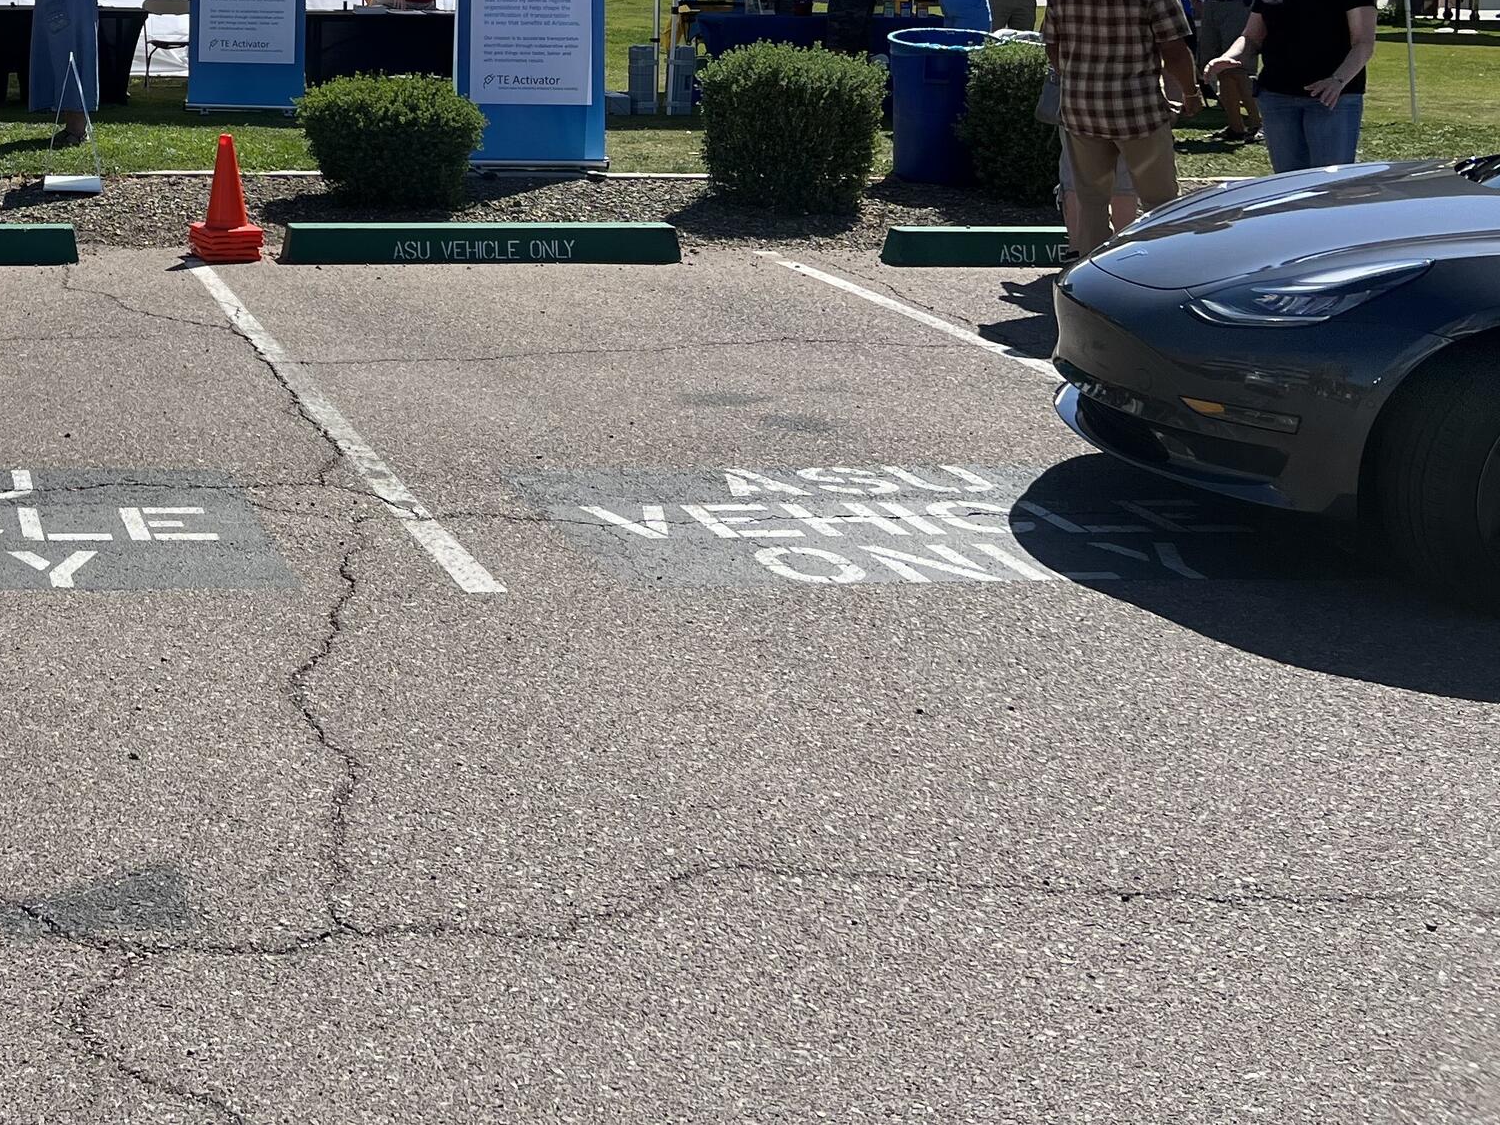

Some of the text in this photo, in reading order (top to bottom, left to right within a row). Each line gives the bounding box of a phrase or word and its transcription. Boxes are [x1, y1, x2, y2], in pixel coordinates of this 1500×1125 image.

[220, 39, 270, 48] TE Activator
[497, 74, 561, 85] TE Activator
[393, 239, 575, 259] ASU VEHICLE ONLY
[1000, 244, 1036, 263] ASU
[723, 464, 994, 497] ASU
[579, 499, 1256, 540] VEHICLE
[753, 542, 1208, 584] ONLY
